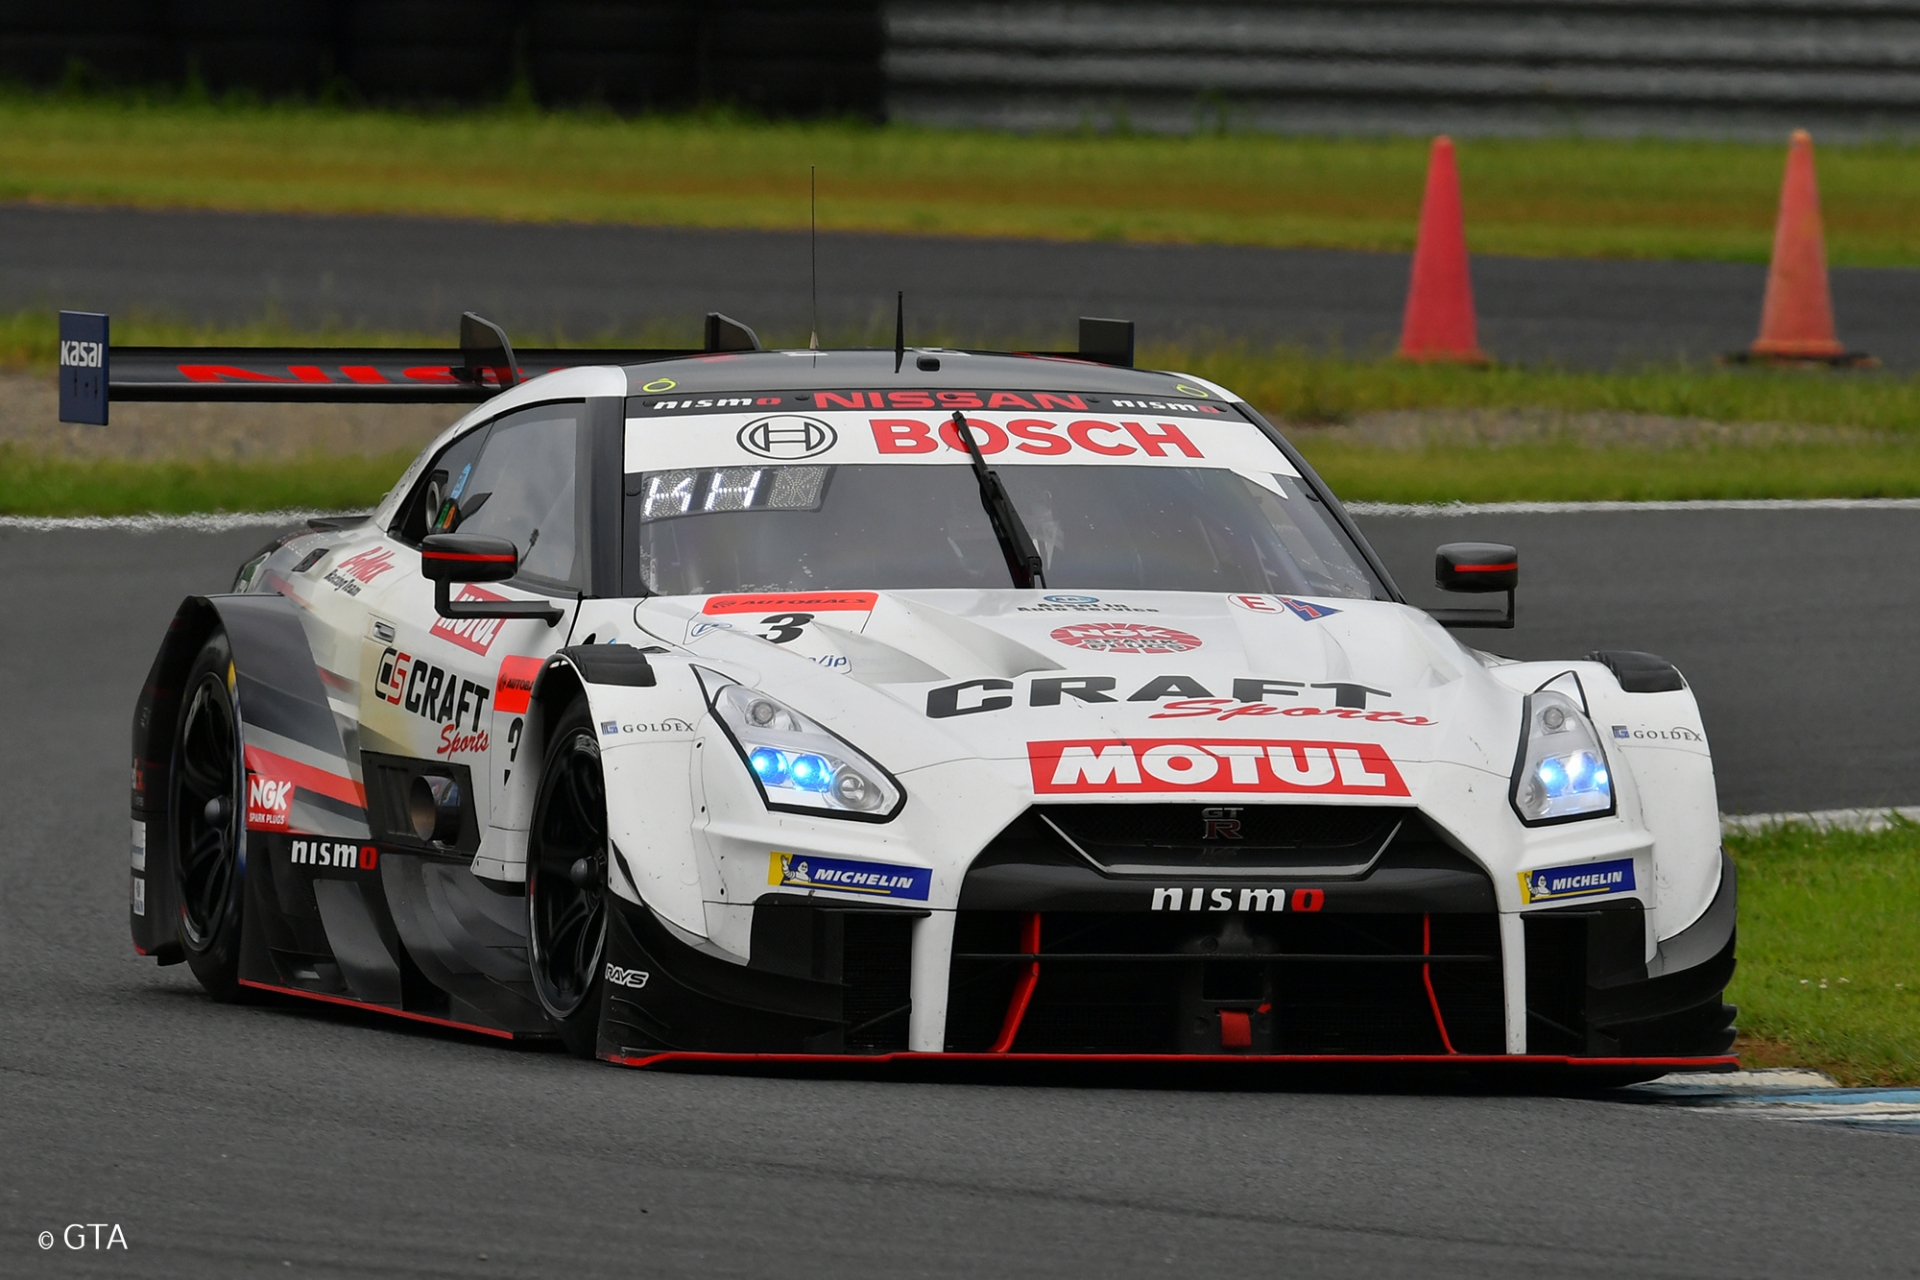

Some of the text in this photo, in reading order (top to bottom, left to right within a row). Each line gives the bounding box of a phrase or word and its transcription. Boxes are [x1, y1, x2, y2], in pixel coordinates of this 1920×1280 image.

[653, 397, 782, 410] nismo
[814, 392, 1089, 410] NISSAN
[1111, 399, 1220, 414] nismo
[869, 418, 1206, 459] BOSCH
[740, 598, 867, 606] AUTOBACS
[756, 613, 815, 644] 3
[1066, 629, 1173, 638] NGK
[405, 659, 490, 733] CRAFT
[925, 674, 1393, 718] CRAFT
[1148, 698, 1440, 727] Sports
[622, 718, 695, 734] GOLDEX
[1633, 726, 1704, 742] GOLDEX
[436, 723, 490, 761] Sports
[1050, 743, 1387, 787] MOTUL
[250, 779, 291, 811] NGK
[249, 812, 285, 825] SPARK PLUGS
[1202, 807, 1244, 818] GT
[1202, 819, 1244, 839] R
[291, 840, 377, 870] nismo
[814, 868, 914, 889] MICHELIN
[1552, 870, 1623, 891] MICHELIN
[1151, 887, 1325, 913] nismo
[605, 963, 649, 988] RAYS
